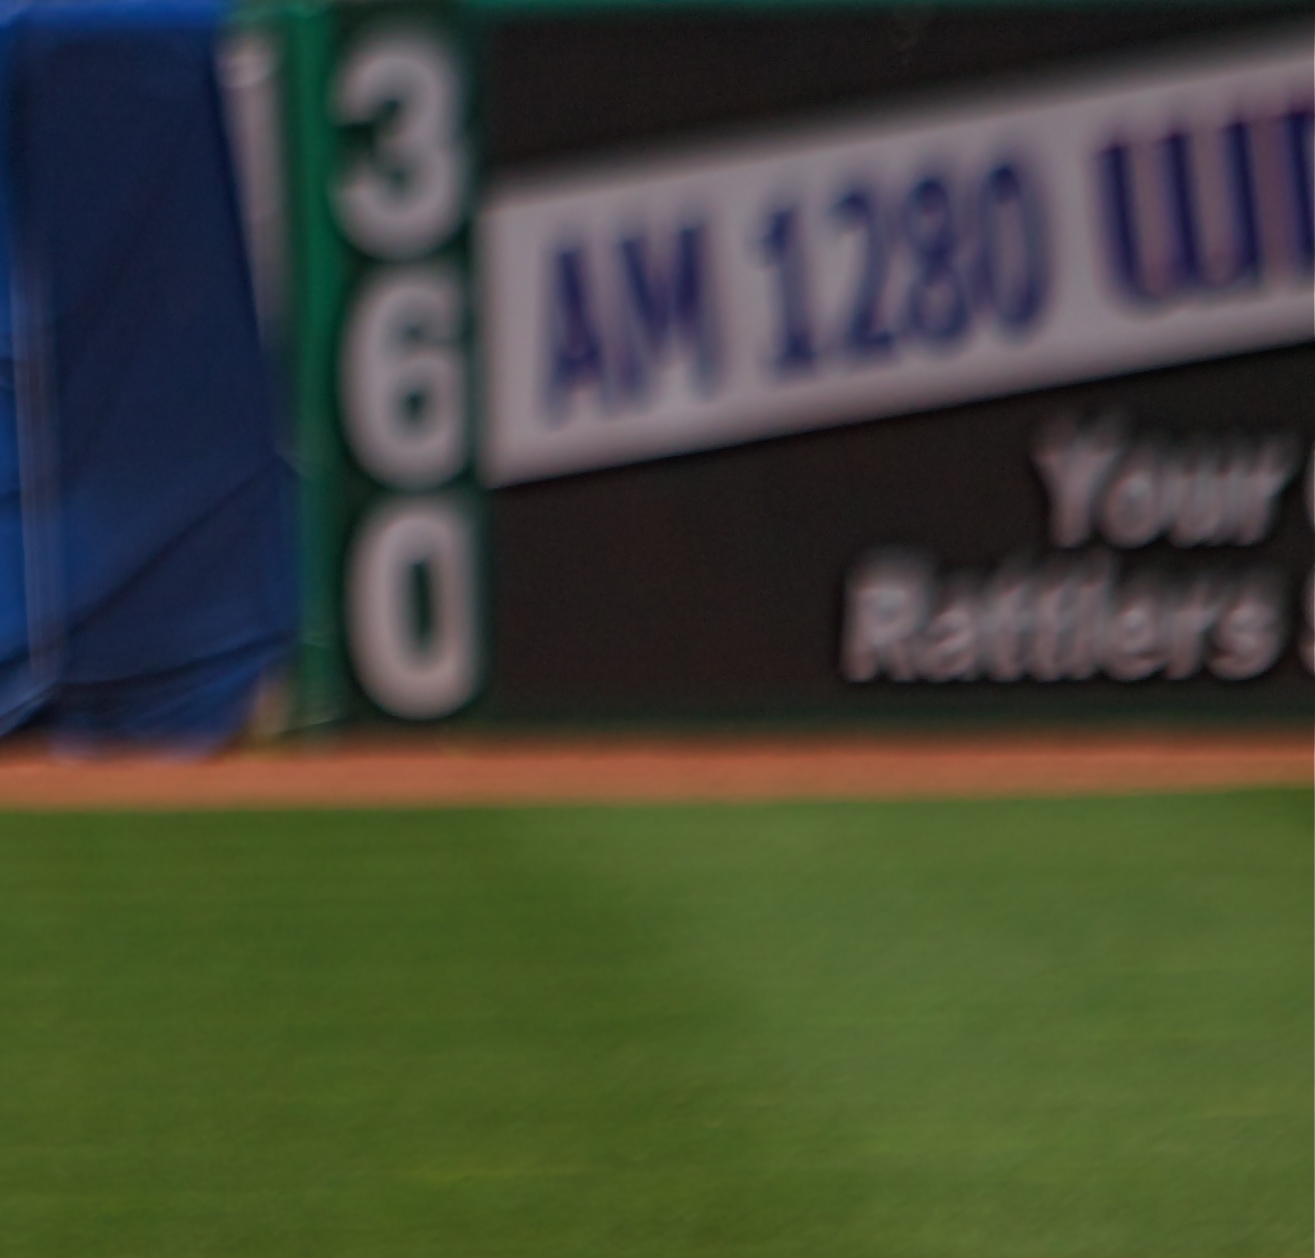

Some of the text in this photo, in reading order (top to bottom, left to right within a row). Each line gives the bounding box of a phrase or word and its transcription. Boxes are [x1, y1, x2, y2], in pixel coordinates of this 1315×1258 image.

[333, 32, 477, 720] 360
[542, 216, 725, 422] AM
[755, 155, 1053, 380] 1280
[1030, 418, 1293, 550] Your
[841, 552, 1283, 683] Rattlers
